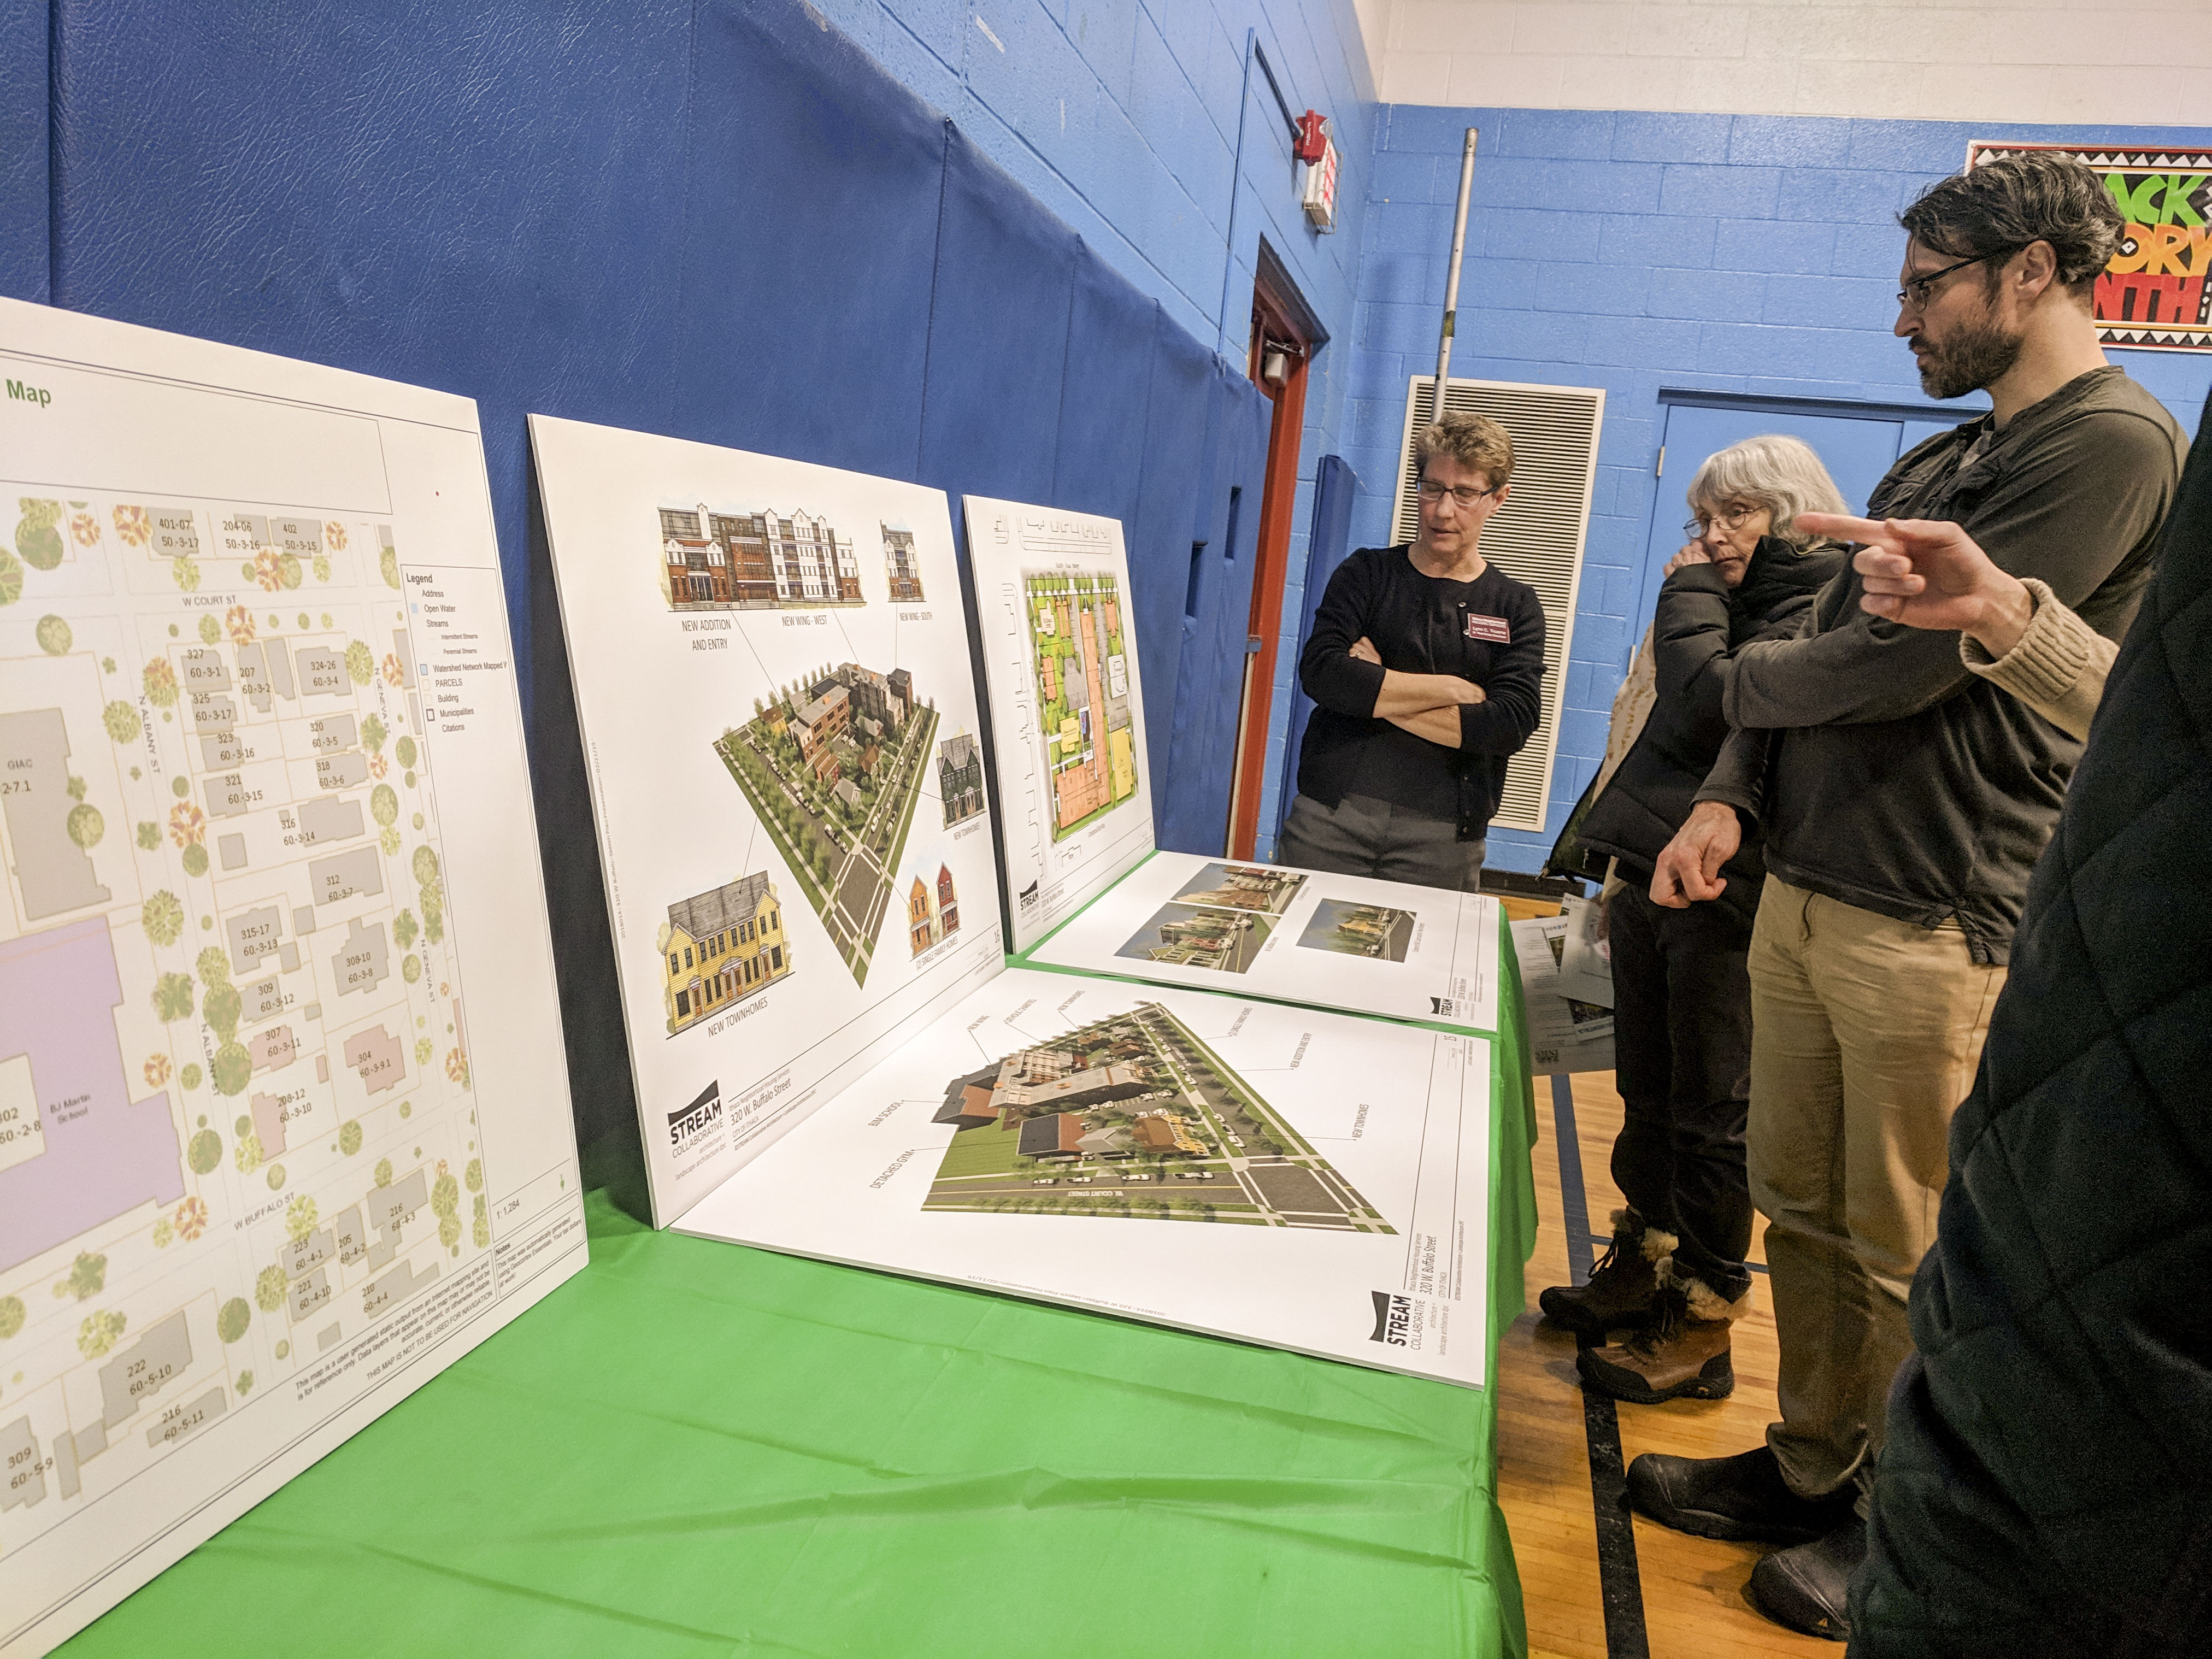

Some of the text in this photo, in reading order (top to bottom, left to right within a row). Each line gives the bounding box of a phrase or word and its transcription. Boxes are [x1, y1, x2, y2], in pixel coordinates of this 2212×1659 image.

[7, 379, 51, 407] Map
[159, 519, 190, 530] 401-07
[223, 521, 251, 532] 204-06
[283, 523, 297, 534] 402
[406, 573, 433, 585] Legend
[183, 596, 236, 607] W COURT ST
[425, 604, 439, 613] Open
[682, 619, 731, 632] NEW ADDITION
[781, 615, 827, 626] NEW WING WEST
[692, 638, 728, 651] AND ENTRY
[187, 649, 203, 659] 327
[310, 661, 336, 670] 324-26
[433, 662, 503, 673] Watershed Network Mapped
[240, 668, 255, 678] 207
[436, 678, 463, 687] PARCELS
[193, 694, 210, 704] 325
[376, 679, 387, 719] GENEVA
[438, 694, 459, 703] Building
[440, 708, 474, 717] Municipalities
[310, 722, 323, 732] 320
[442, 724, 464, 733] Citations
[138, 696, 160, 773] N ALBANY ST
[218, 734, 233, 744] 323
[316, 762, 330, 771] 318
[225, 775, 242, 786] 321
[281, 819, 295, 829] 316
[326, 875, 340, 886] 312
[1021, 890, 1039, 910] STREAM
[241, 924, 269, 940] 315-17
[995, 929, 1000, 944] 16
[922, 950, 934, 966] SINGLE
[934, 943, 946, 959] FAMILY
[946, 936, 958, 950] HOMES
[346, 952, 371, 967] 308-10
[420, 939, 435, 1003] N GENEVA ST
[258, 984, 273, 996] 309
[1440, 998, 1453, 1016] STREAM
[708, 996, 768, 1038] NEW TOWNHOMES
[201, 1023, 208, 1033] N
[266, 1027, 281, 1040] 307
[358, 1051, 372, 1063] 304
[278, 1089, 305, 1107] 208-12
[730, 1078, 791, 1126] 320 W. Buffalo Street
[879, 1101, 904, 1120] SCHOOL
[670, 1099, 722, 1145] STREAM
[672, 1118, 724, 1158] COLLABORATIVE
[870, 1151, 915, 1189] DETACHED GYM
[233, 1192, 295, 1231] W BUFFALO ST
[390, 1203, 403, 1217] 216
[503, 1198, 520, 1216] 1,284
[293, 1239, 308, 1254] 223
[338, 1234, 351, 1249] 205
[1424, 1236, 1437, 1252] Street
[496, 1243, 511, 1256] Notes
[1422, 1253, 1435, 1274] Buffalo
[297, 1280, 312, 1295] 221
[362, 1283, 375, 1297] 210
[1420, 1282, 1432, 1295] 320
[1387, 1295, 1411, 1346] STREAM
[1411, 1299, 1425, 1350] COLLABORATIVE
[367, 1289, 493, 1381] THIS MAP IS NOT TO BE USED FOR NAVIGATION
[127, 1360, 146, 1377] 222
[162, 1404, 181, 1424] 216
[7, 1448, 31, 1469] 309
